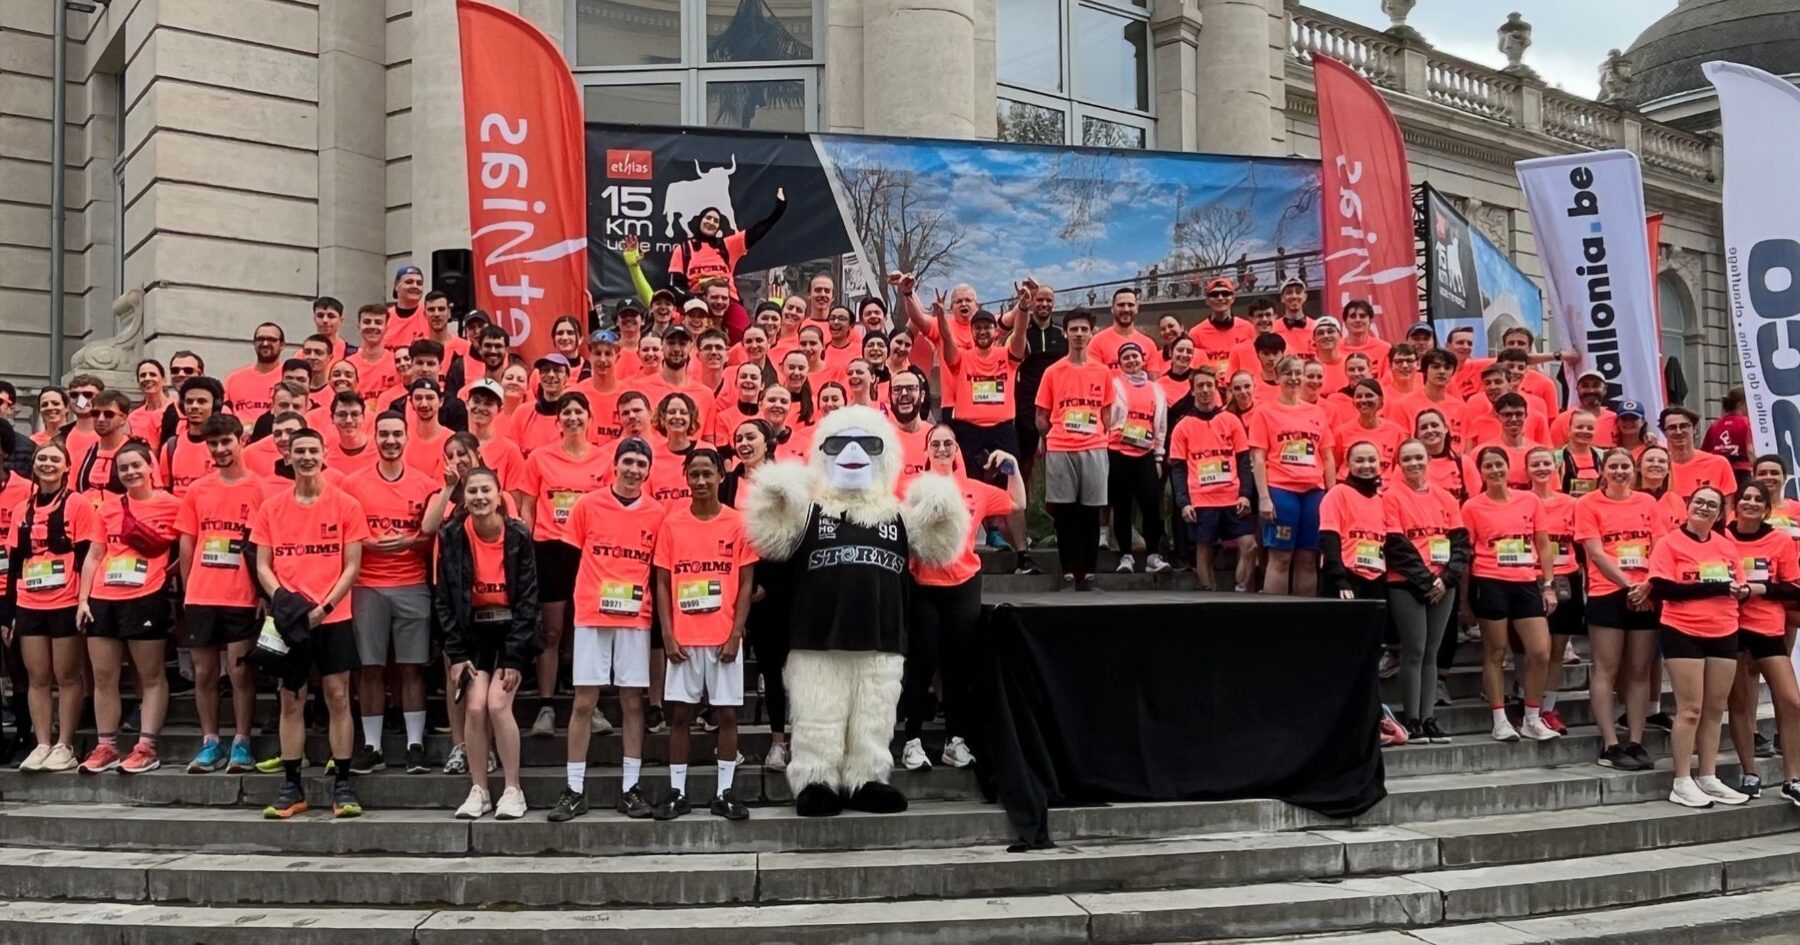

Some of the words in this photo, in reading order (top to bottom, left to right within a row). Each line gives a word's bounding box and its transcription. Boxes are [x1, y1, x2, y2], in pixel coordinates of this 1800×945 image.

[611, 152, 648, 175] ethias
[601, 186, 653, 217] 15
[878, 523, 898, 541] 99
[275, 542, 340, 557] STORMS
[809, 546, 904, 573] STORMS
[674, 561, 732, 575] STORMS
